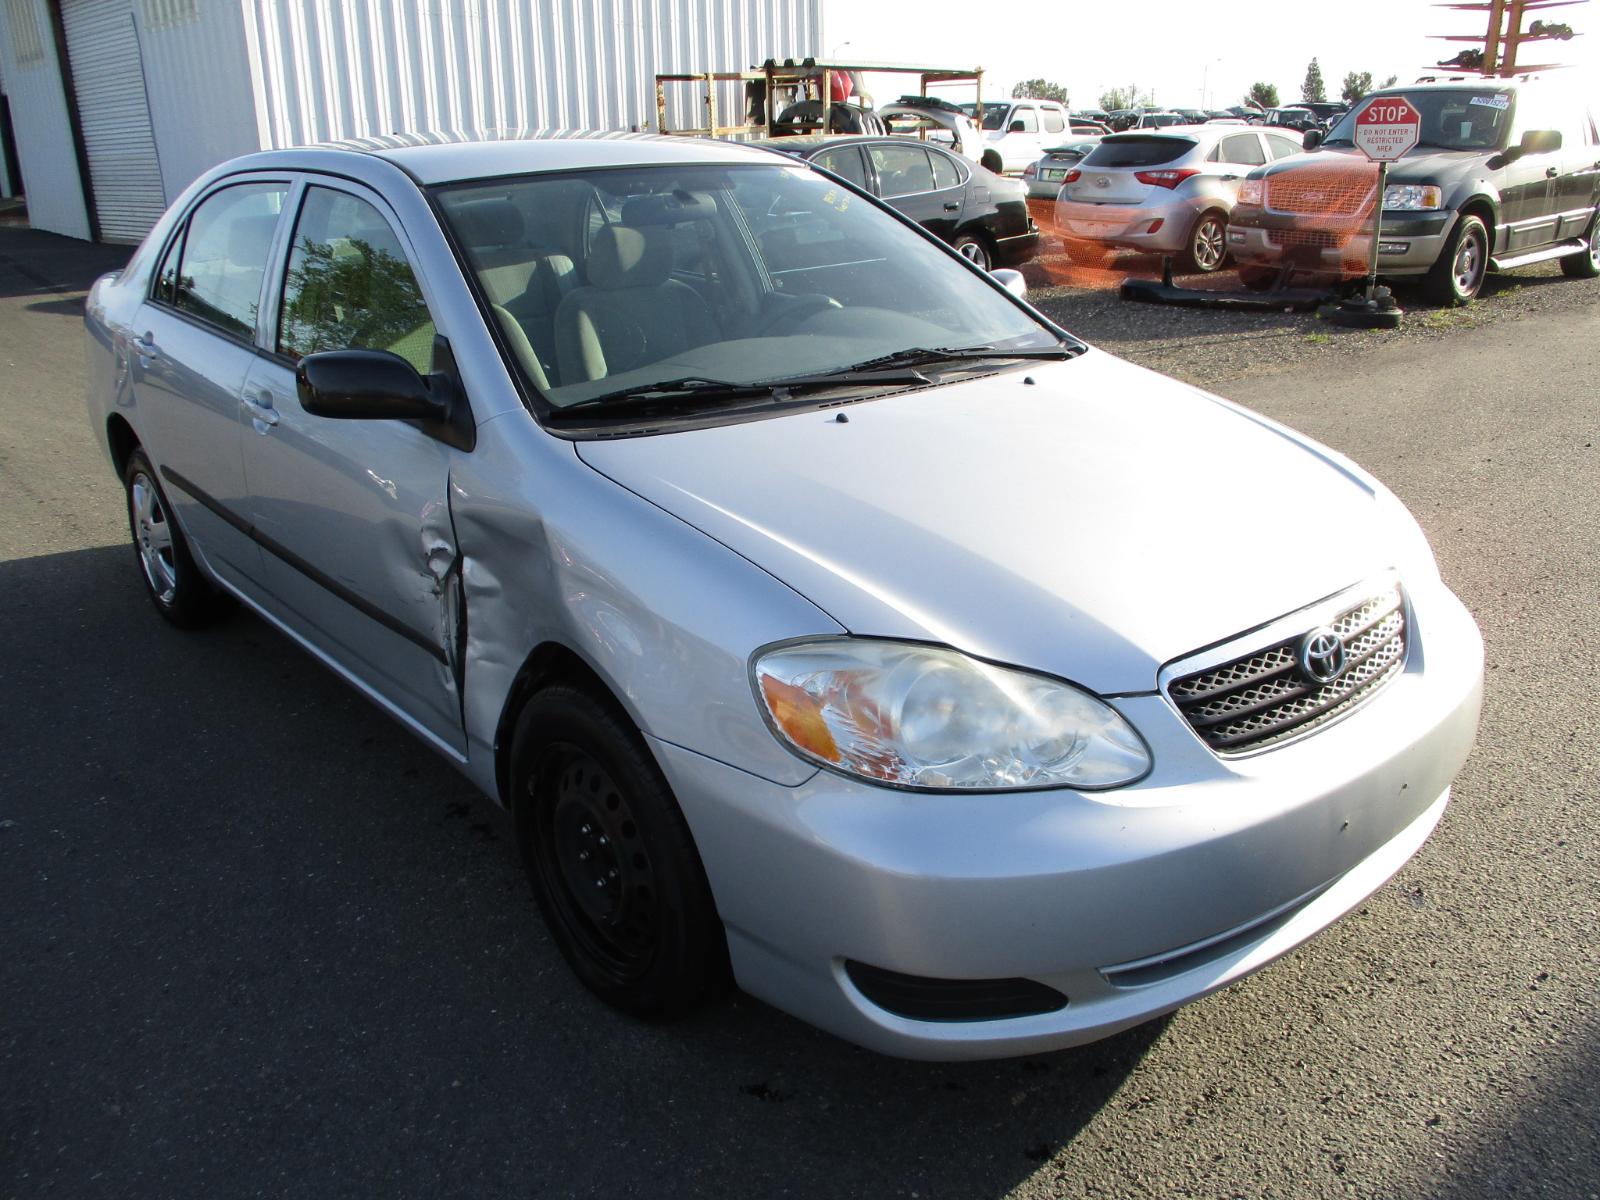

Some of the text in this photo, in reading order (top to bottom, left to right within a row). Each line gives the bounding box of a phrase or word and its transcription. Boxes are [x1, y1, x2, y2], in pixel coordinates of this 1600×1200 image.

[1368, 106, 1408, 122] STOP
[1388, 128, 1409, 136] ENTER
[1366, 136, 1404, 144] RESTRICTED
